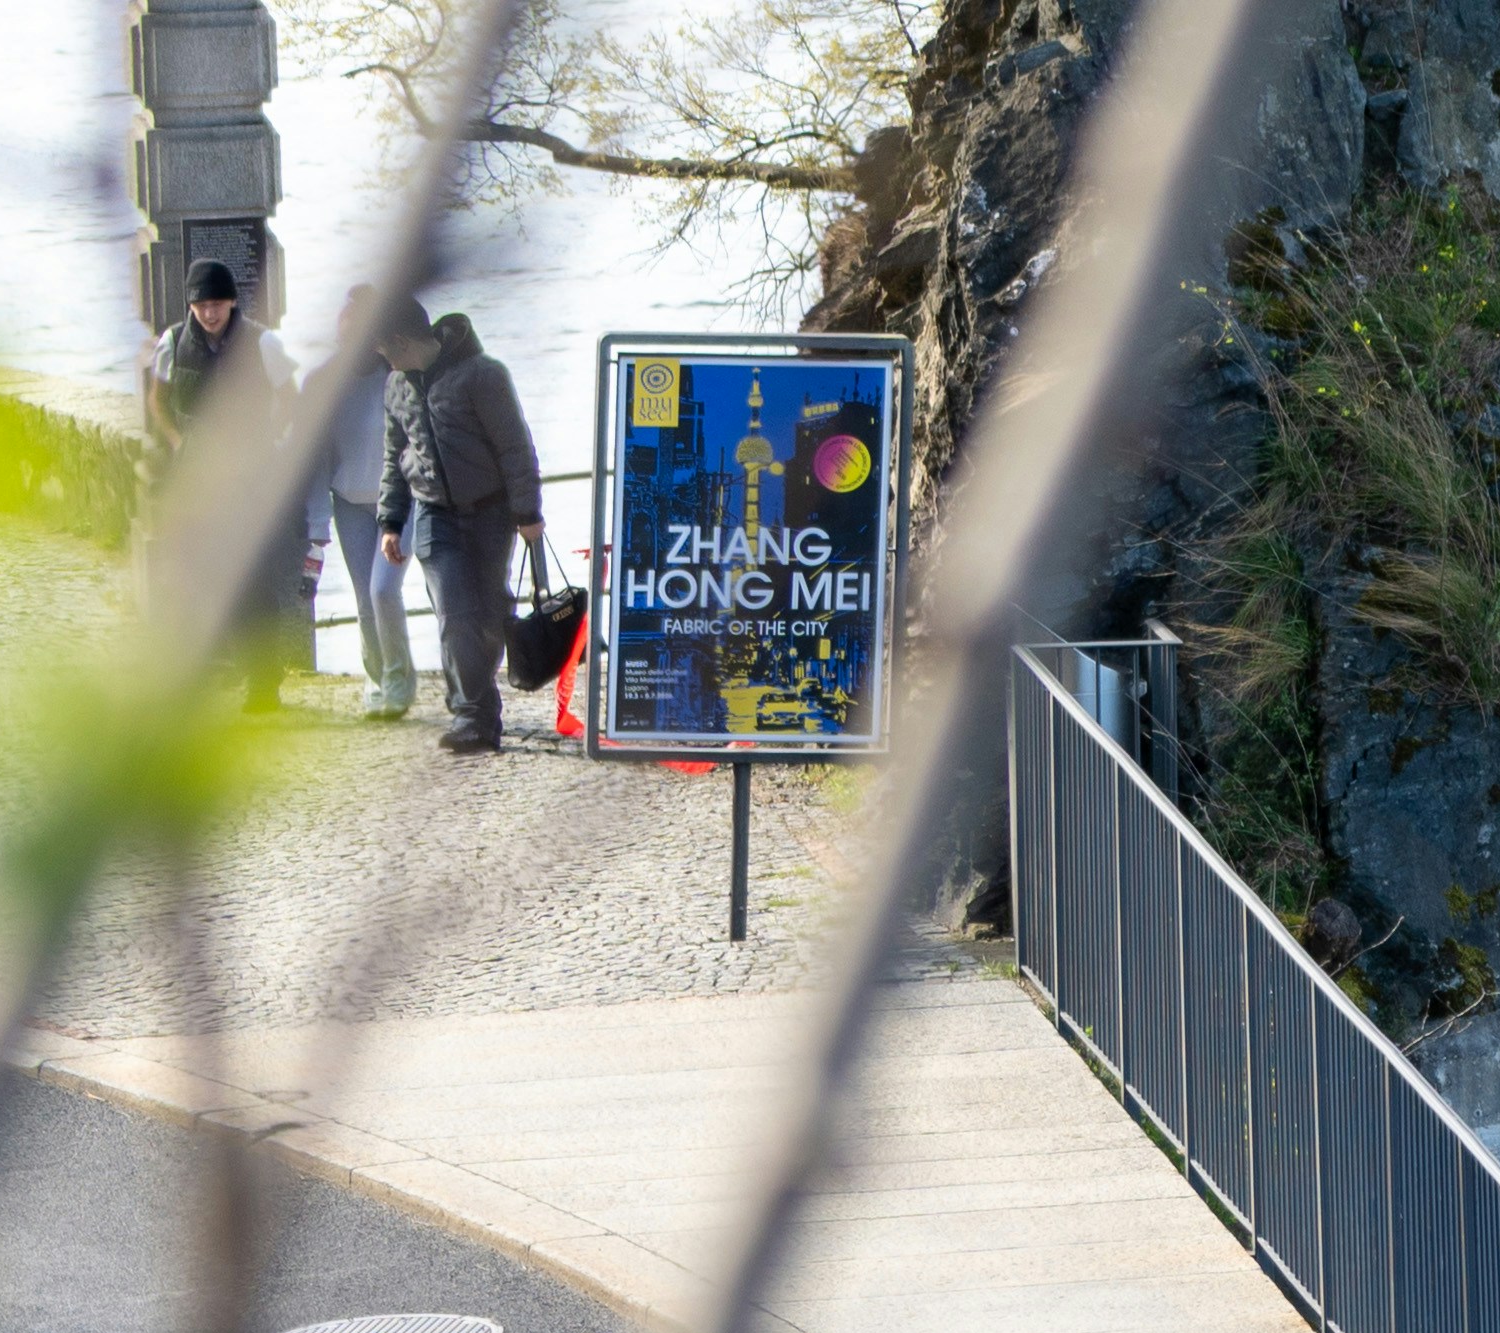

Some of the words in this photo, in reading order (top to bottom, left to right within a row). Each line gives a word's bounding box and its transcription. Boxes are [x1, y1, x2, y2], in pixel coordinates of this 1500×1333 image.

[666, 524, 832, 566] ZHANG
[626, 569, 774, 610] HONG
[791, 571, 870, 612] MEI
[664, 618, 723, 636] FABRIC
[728, 619, 753, 636] OF
[757, 620, 787, 637] THE
[791, 620, 828, 637] CITY
